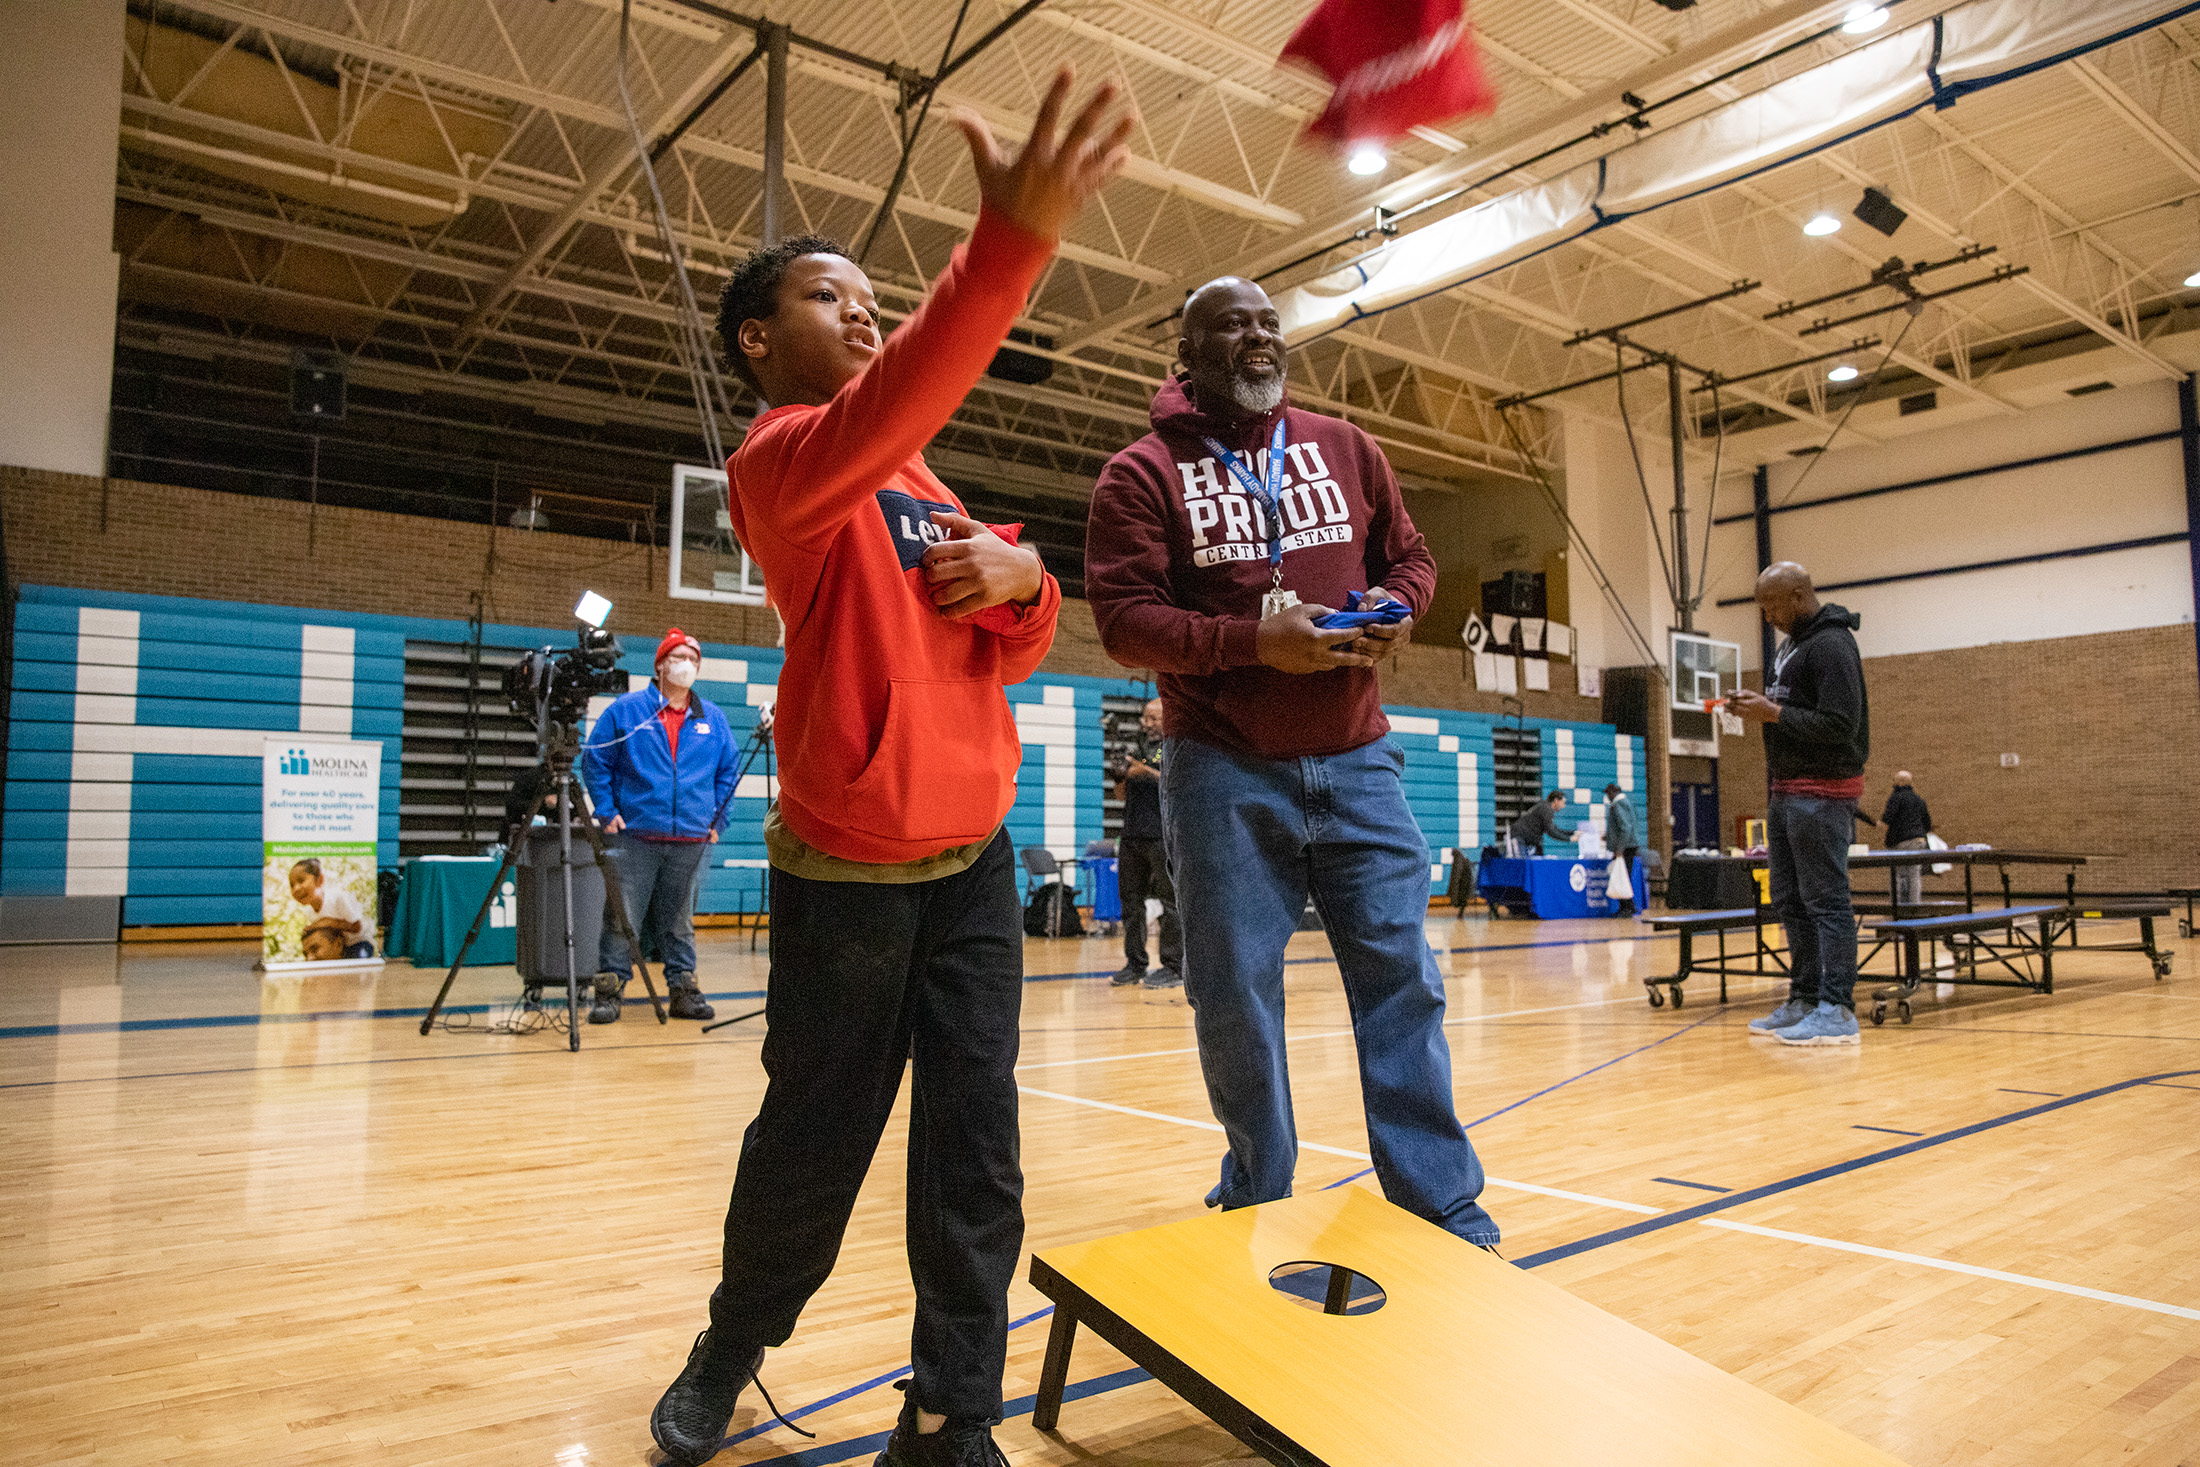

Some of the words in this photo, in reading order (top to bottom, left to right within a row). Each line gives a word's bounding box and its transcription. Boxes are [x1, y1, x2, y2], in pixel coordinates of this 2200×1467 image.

[1229, 460, 1252, 483] HAWKS
[1246, 478, 1273, 507] HAMADY
[1206, 544, 1287, 564] CENTRL
[1294, 526, 1345, 547] STATE
[312, 758, 368, 770] MOLINA
[312, 769, 368, 778] HEALTHCARE
[281, 788, 297, 797] For
[269, 800, 319, 811] delivering
[321, 801, 354, 812] quality
